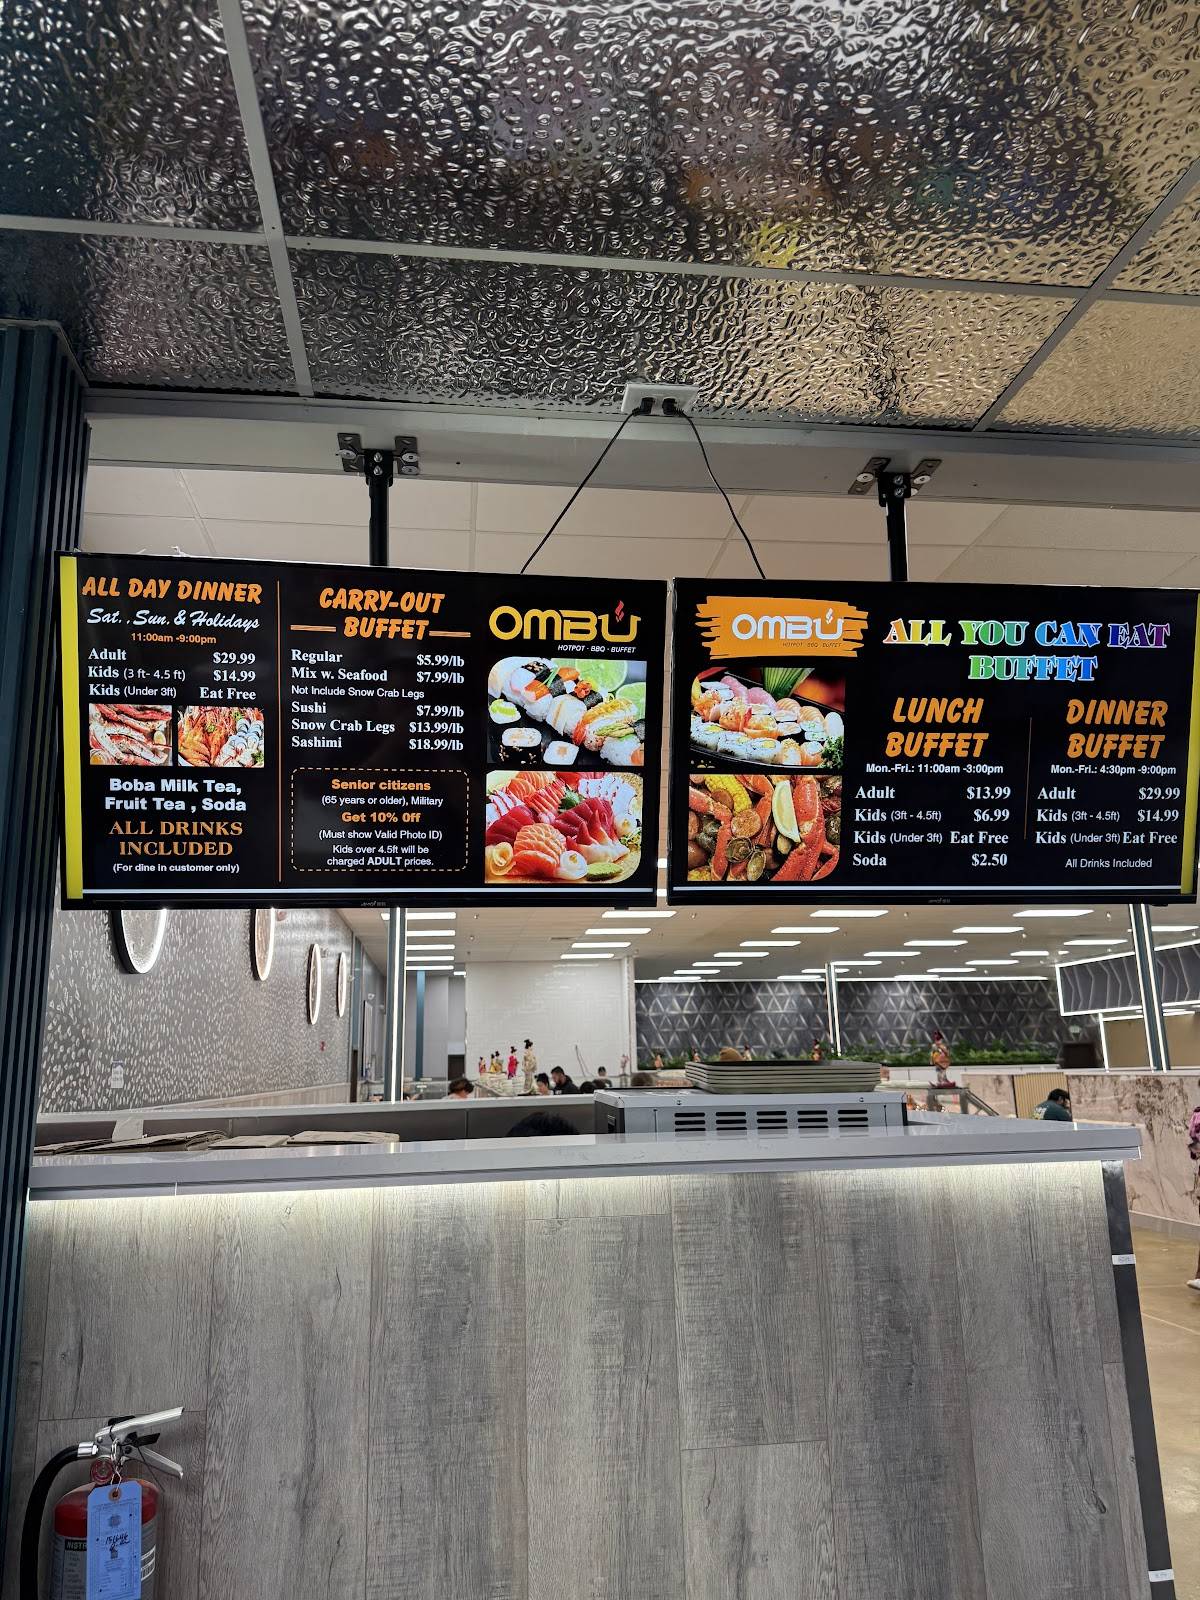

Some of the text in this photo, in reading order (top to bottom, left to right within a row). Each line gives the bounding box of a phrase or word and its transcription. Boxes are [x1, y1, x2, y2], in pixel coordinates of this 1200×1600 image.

[82, 577, 262, 604] ALL DAY DINNER
[320, 588, 445, 613] CARRY-OUT
[174, 610, 186, 625] &
[189, 611, 259, 632] Holidays
[344, 616, 429, 640] BUFFET
[883, 618, 1170, 649] ALL YOU CAN EAT
[131, 633, 216, 645] 11:00am -9:00pm
[88, 648, 127, 660] Adult
[213, 652, 256, 664] $29.99
[291, 649, 343, 664] Regular
[416, 654, 464, 667] $5.99/lb
[88, 666, 119, 678] Kids
[154, 669, 170, 679] 4.5
[173, 669, 186, 681] ft)
[291, 667, 388, 681] Mix w. Seafood
[968, 655, 1098, 682] BUFFET
[213, 670, 256, 682] $14.99
[416, 671, 464, 683] $7.99/lb
[89, 684, 177, 698] Kids (Under 3ft)
[200, 687, 256, 700] Eat Free
[292, 685, 424, 700] Not Include Snow Crab Legs
[292, 701, 326, 713] Sushi
[416, 705, 464, 717] $7.99/lb
[893, 697, 984, 724] LUNCH
[1066, 699, 1168, 728] DINNER
[292, 719, 395, 734] Snow Crab Legs
[409, 721, 464, 734] $13.99/lb
[292, 736, 342, 748] Sashimi
[409, 738, 464, 750] $18.99/lb
[885, 732, 989, 757] BUFFET
[1067, 733, 1166, 759] BUFFET
[866, 764, 1003, 775] Mon.-Fri.: 11:00am -3:00pm
[1051, 765, 1176, 776] Mon.-Fri.: 4:30pm -9:00pm
[110, 778, 242, 795] Boba Milk Tea,
[332, 779, 431, 791] Senior citizens
[855, 786, 895, 798] Adult
[967, 787, 1011, 799] $13.99
[1037, 787, 1076, 799] Adult
[1139, 787, 1180, 800] $29.99
[105, 797, 147, 810] Fruit
[152, 798, 185, 810] Tea
[202, 798, 246, 810] Soda
[322, 796, 443, 807] (65 years or older), Military
[342, 813, 366, 822] Get
[370, 813, 398, 822] 10%
[855, 809, 887, 821] Kids
[891, 811, 907, 822] (3ft
[916, 811, 942, 822] 4.5ft)
[974, 809, 1010, 822] $6.99
[1037, 809, 1068, 821] Kids
[1071, 812, 1087, 822] (3ft
[1096, 811, 1120, 822] 4.5ft)
[1137, 809, 1179, 822] $14.99
[109, 821, 243, 835] ALL DRINKS
[319, 830, 442, 840] (Must show Valid Photo ID)
[854, 831, 942, 844] Kids (Under 3ft)
[950, 831, 1008, 844] Eat Free
[1035, 832, 1120, 844] Kids (Under 3ft)
[1123, 832, 1178, 844] Eat Free
[119, 841, 233, 855] INCLUDED
[333, 845, 353, 853] Kids
[378, 845, 398, 853] 4.5ft
[401, 845, 415, 853] will
[417, 845, 429, 853] be
[327, 857, 434, 867] charged ADULT prices.
[853, 853, 887, 866] Soda
[972, 853, 1008, 866] $2.50
[1065, 859, 1152, 868] All Drinks Included
[113, 863, 240, 873] (For dine in customer only)
